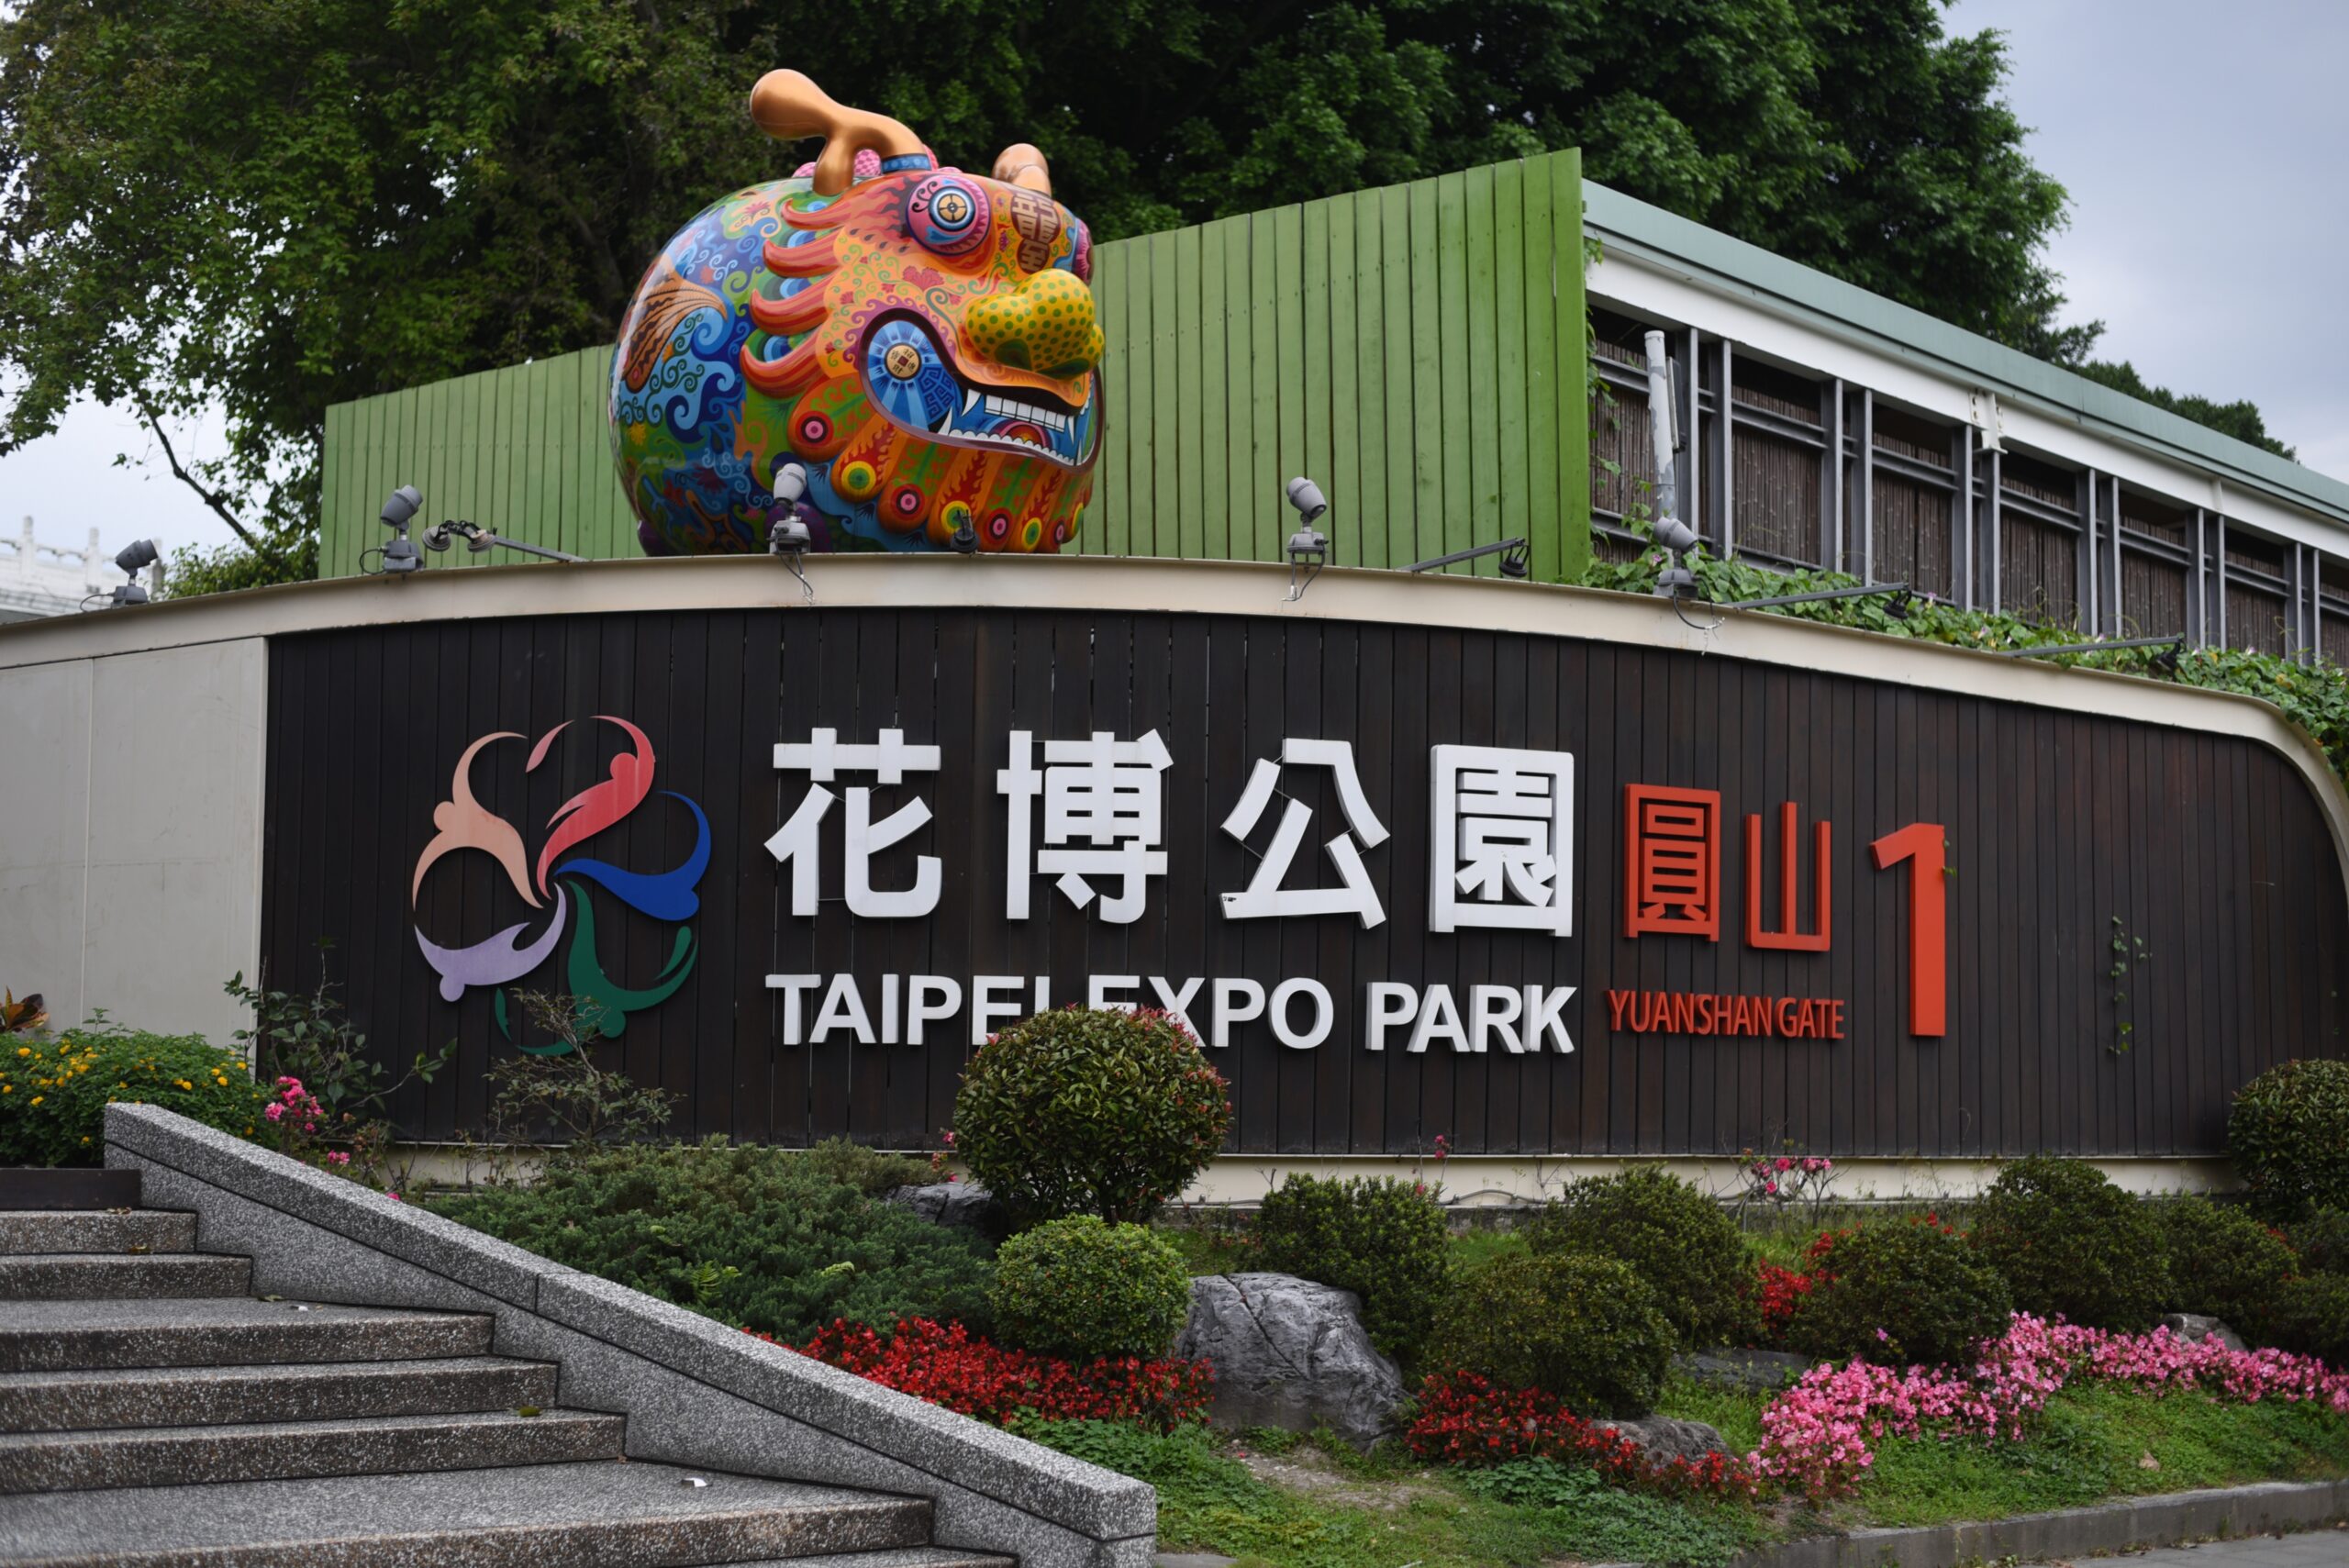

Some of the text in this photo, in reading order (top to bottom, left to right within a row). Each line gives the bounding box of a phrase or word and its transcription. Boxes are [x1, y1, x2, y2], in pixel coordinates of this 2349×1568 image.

[763, 727, 1575, 938] 花博公園
[1622, 783, 1946, 1037] 圓山 1
[1364, 981, 1578, 1054] PARK
